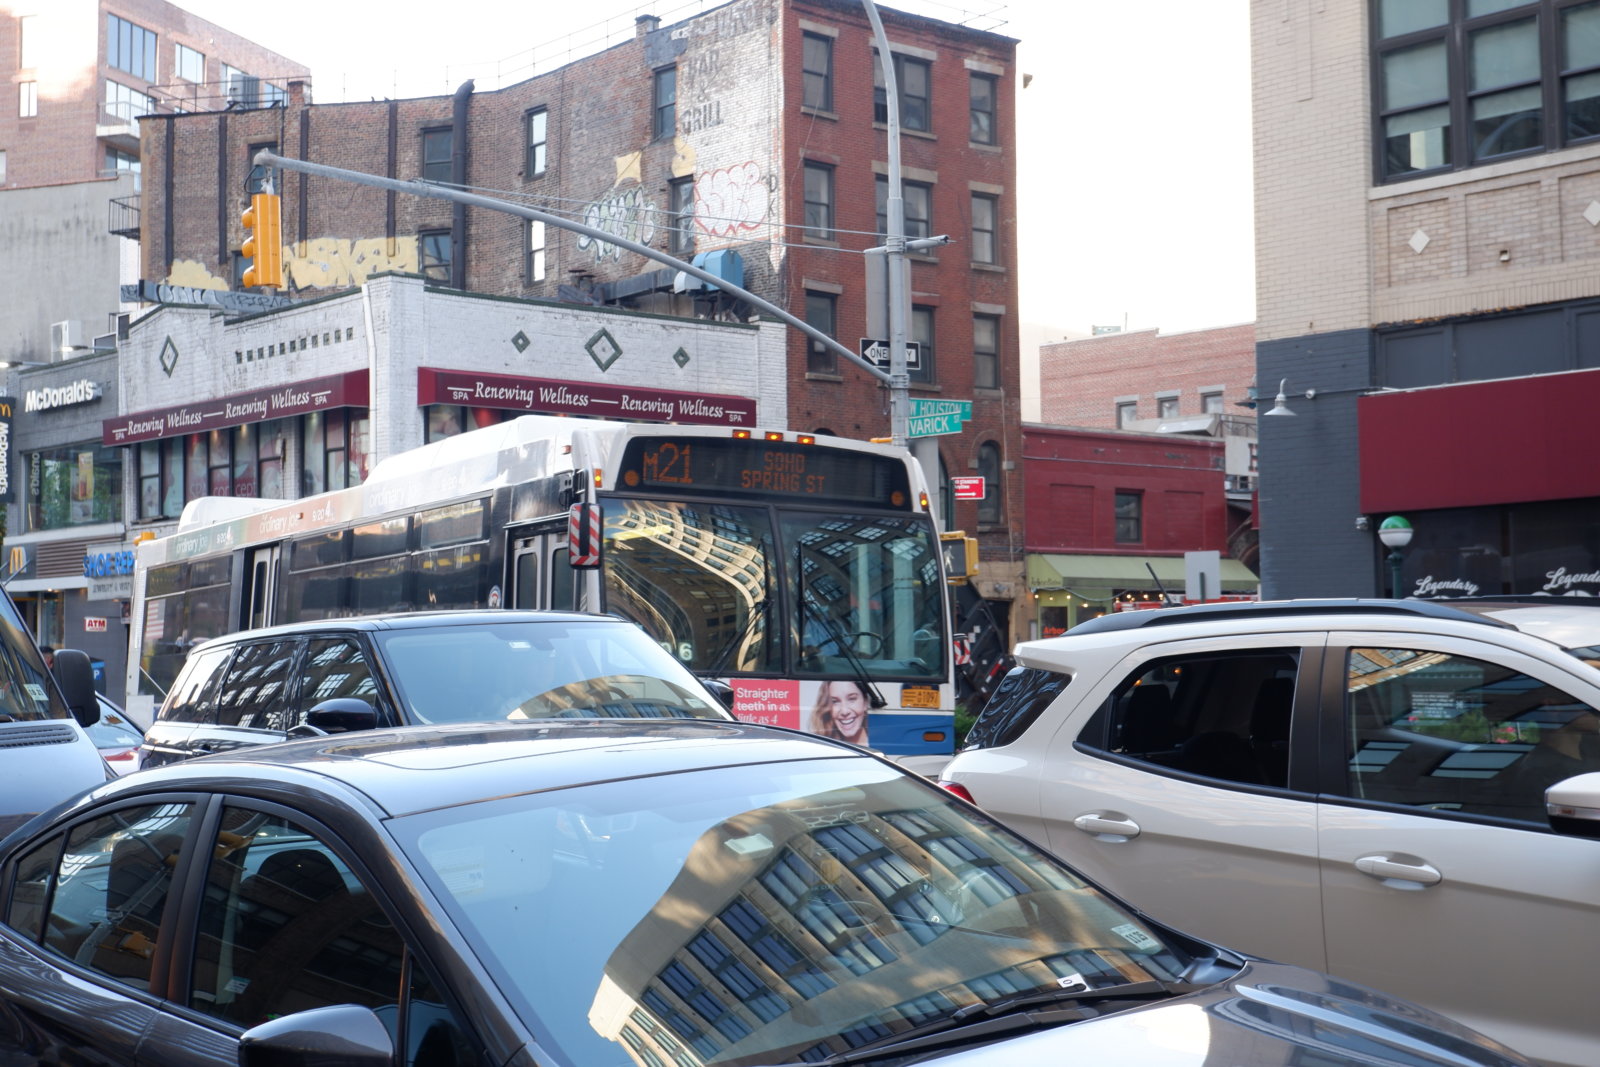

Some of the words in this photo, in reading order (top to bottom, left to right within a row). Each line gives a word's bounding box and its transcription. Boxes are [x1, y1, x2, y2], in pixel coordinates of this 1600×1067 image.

[870, 347, 888, 359] ONE
[25, 379, 94, 413] McDonald's
[452, 391, 469, 400] SPA
[475, 382, 534, 407] Renewing
[540, 388, 589, 406] Wellness
[621, 395, 674, 420] Renewing
[679, 400, 724, 418] Wellness
[728, 413, 743, 422] SPA
[115, 432, 125, 440] SPA
[127, 419, 164, 436] Renewing
[168, 410, 202, 427] Wellness
[225, 399, 268, 420] Renewing
[271, 390, 310, 410] Wellness
[315, 396, 328, 406] SPA
[910, 416, 950, 435] VARICK
[643, 443, 693, 483] M21
[764, 451, 806, 473] SOHO
[741, 470, 799, 493] SPRING
[806, 475, 825, 493] ST
[83, 552, 114, 578] SHOE
[1413, 575, 1479, 596] Legendary
[88, 619, 105, 627] ATM
[736, 687, 789, 701] Straighter
[736, 701, 765, 711] teeth
[767, 701, 777, 711] in
[779, 703, 790, 711] as
[758, 716, 769, 724] as
[770, 714, 778, 724] 4
